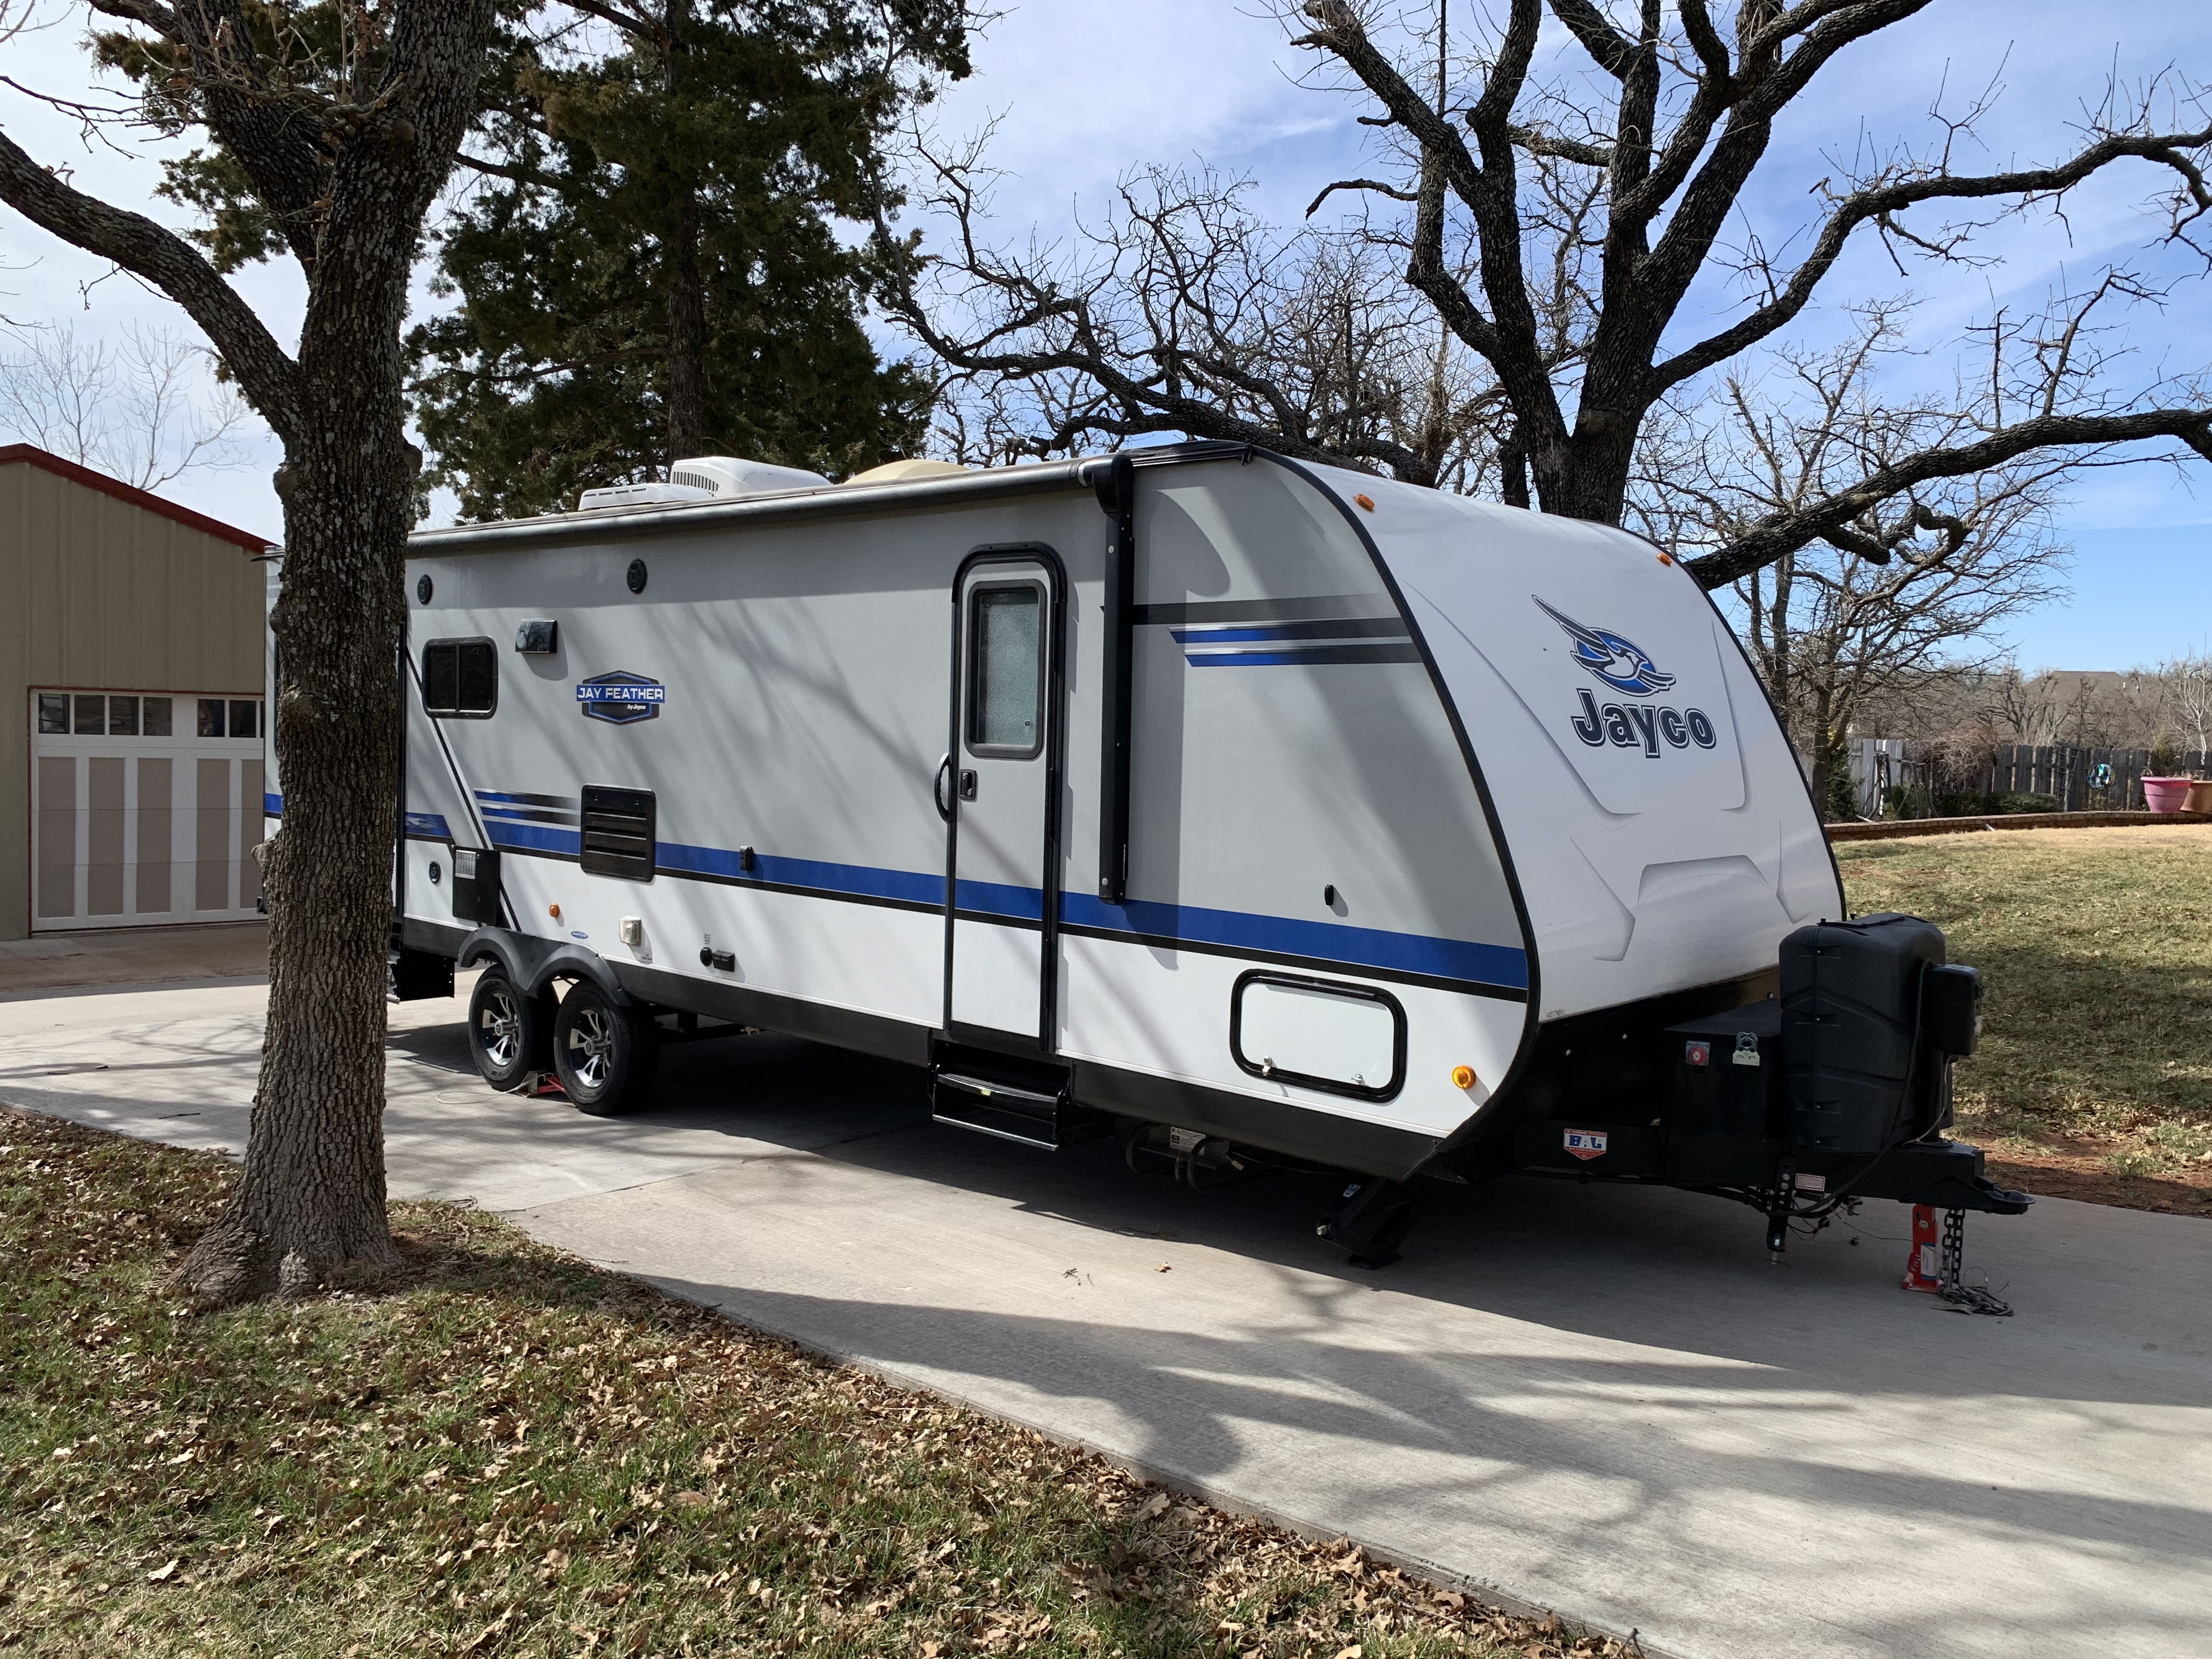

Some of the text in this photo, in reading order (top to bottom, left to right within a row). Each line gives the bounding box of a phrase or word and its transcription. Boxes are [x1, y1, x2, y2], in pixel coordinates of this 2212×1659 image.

[578, 687, 663, 700] JAY FEATHER
[1571, 688, 1717, 758] Jayco
[1569, 1135, 1602, 1149] BAL
